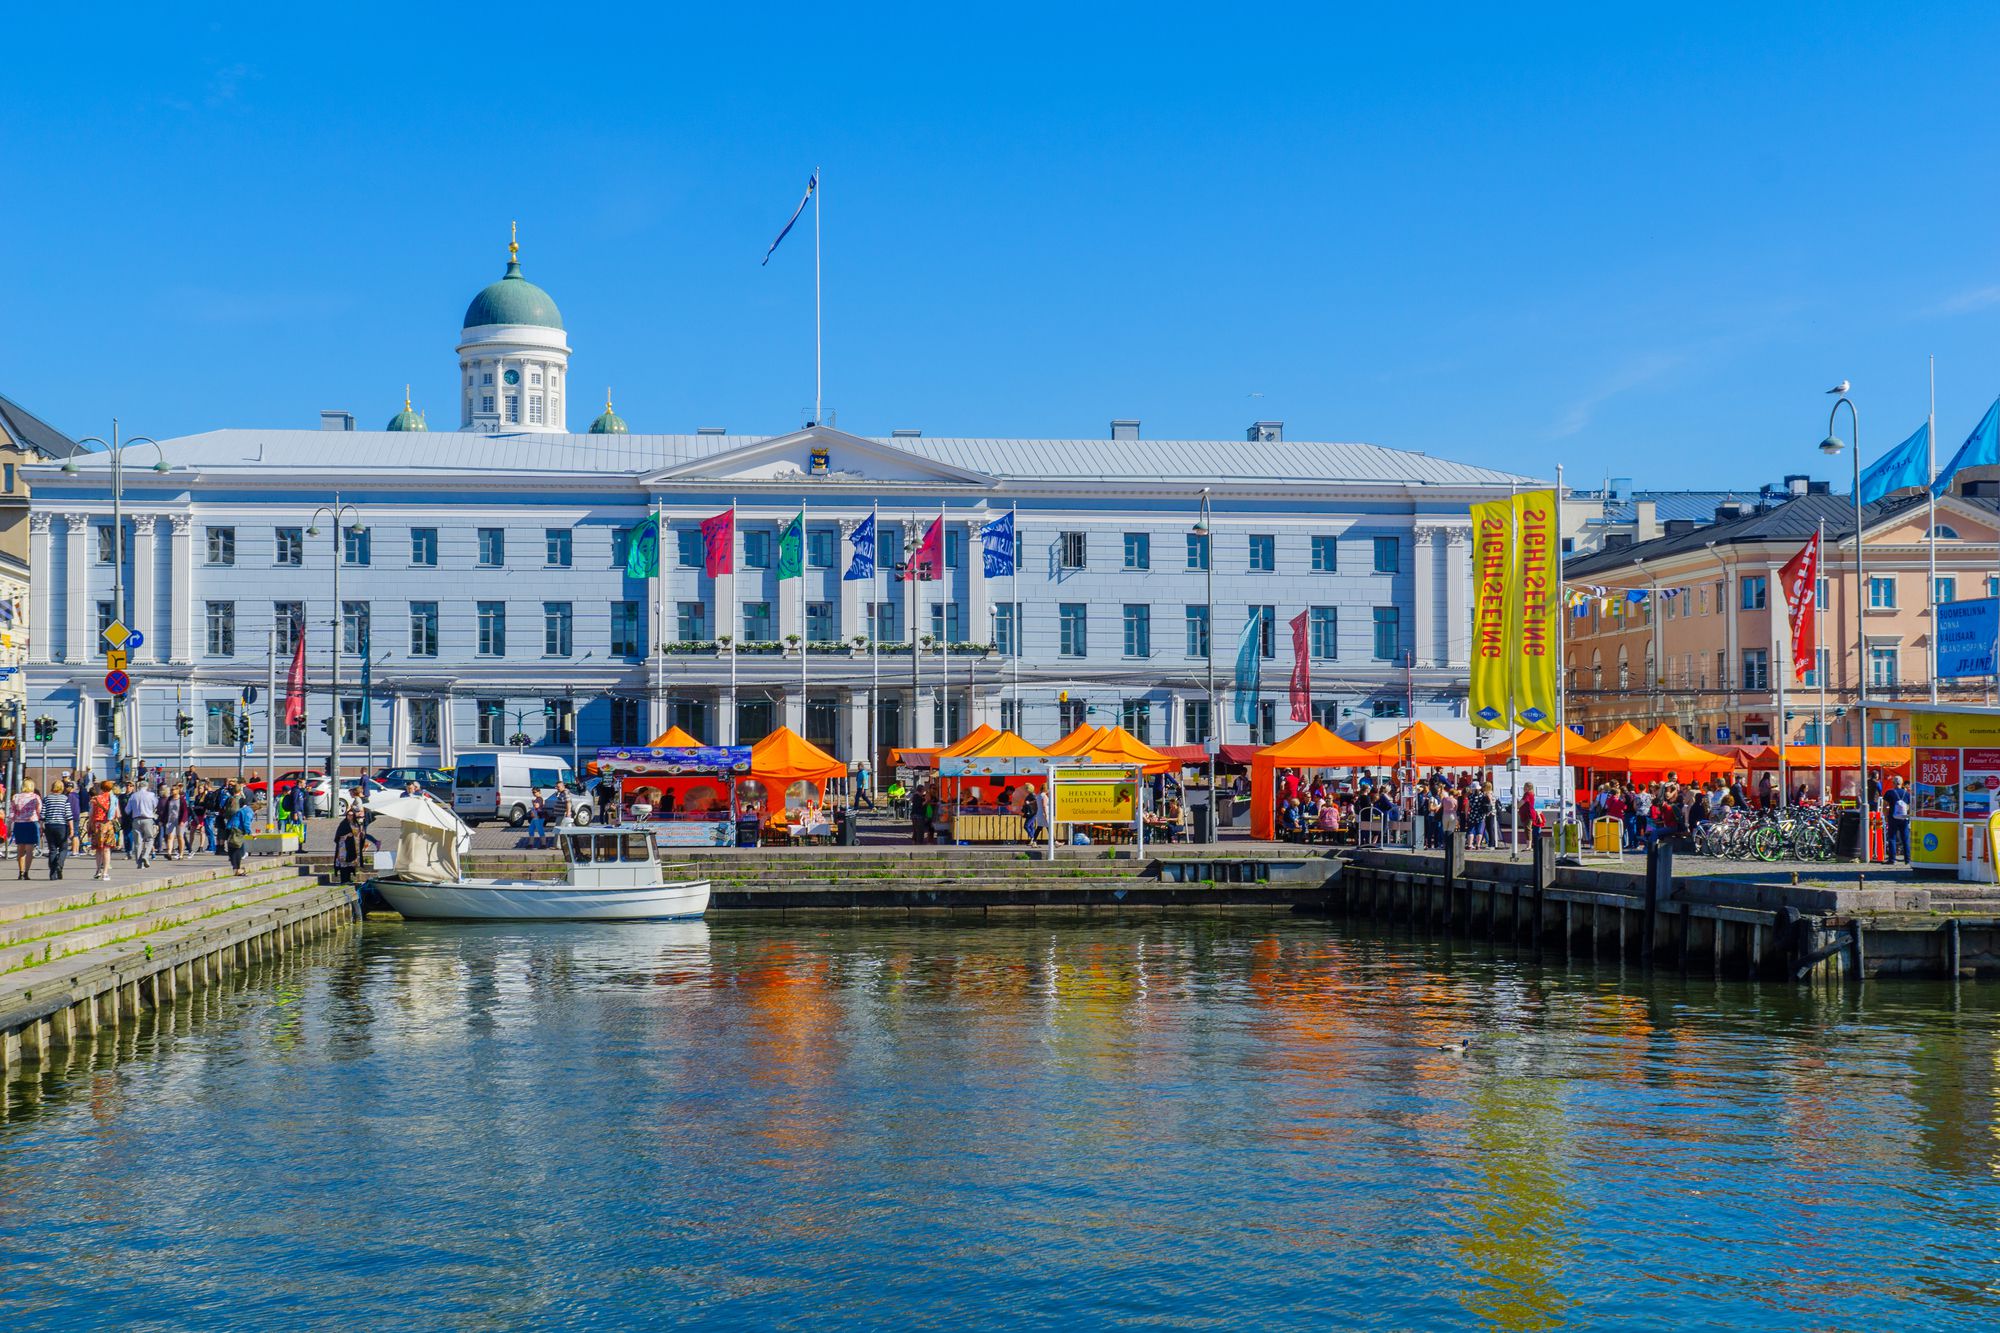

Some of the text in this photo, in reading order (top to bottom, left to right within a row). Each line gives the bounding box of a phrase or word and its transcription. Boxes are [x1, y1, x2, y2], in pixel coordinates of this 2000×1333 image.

[1940, 606, 1986, 619] SUOMENLINNA
[1940, 631, 1976, 642] VALLISAARI
[1922, 763, 1948, 773] BUS &
[1922, 773, 1948, 783] BOAT
